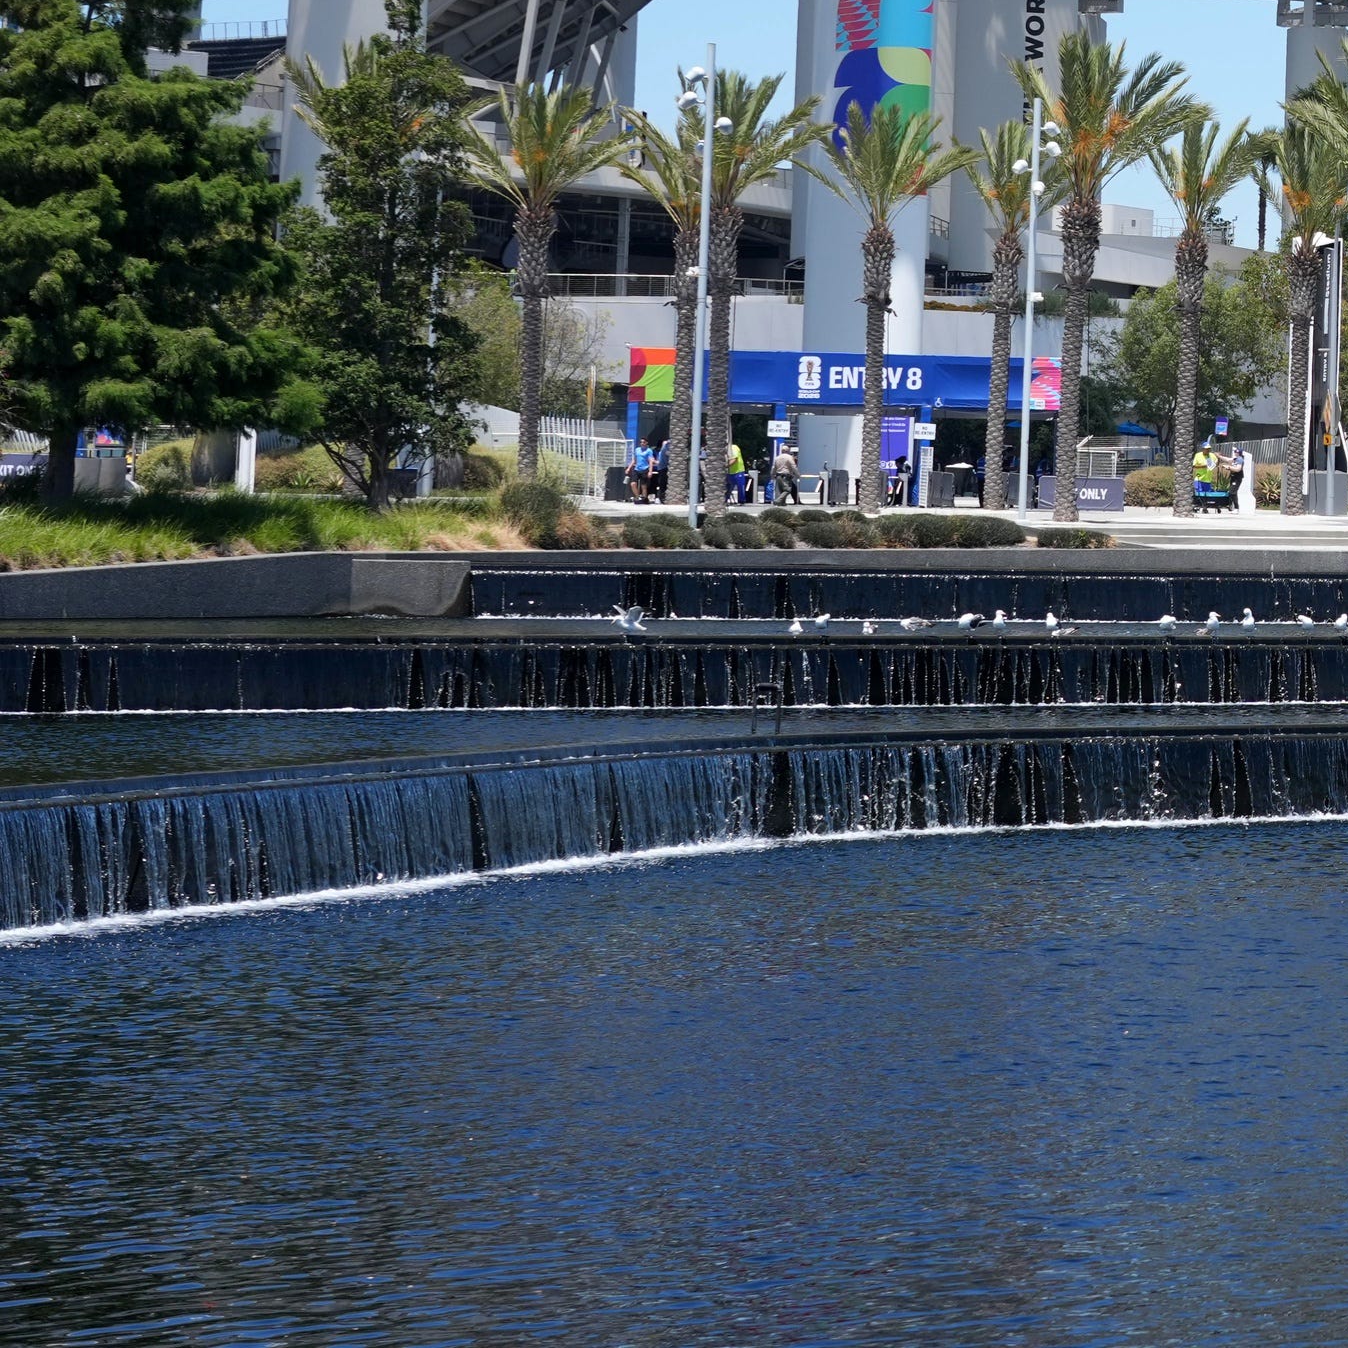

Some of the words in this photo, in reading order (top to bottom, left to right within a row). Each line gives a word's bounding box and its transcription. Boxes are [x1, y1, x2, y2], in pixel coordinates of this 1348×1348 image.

[906, 367, 922, 390] 8
[0, 464, 14, 477] XIT
[1079, 488, 1108, 500] ONLY
